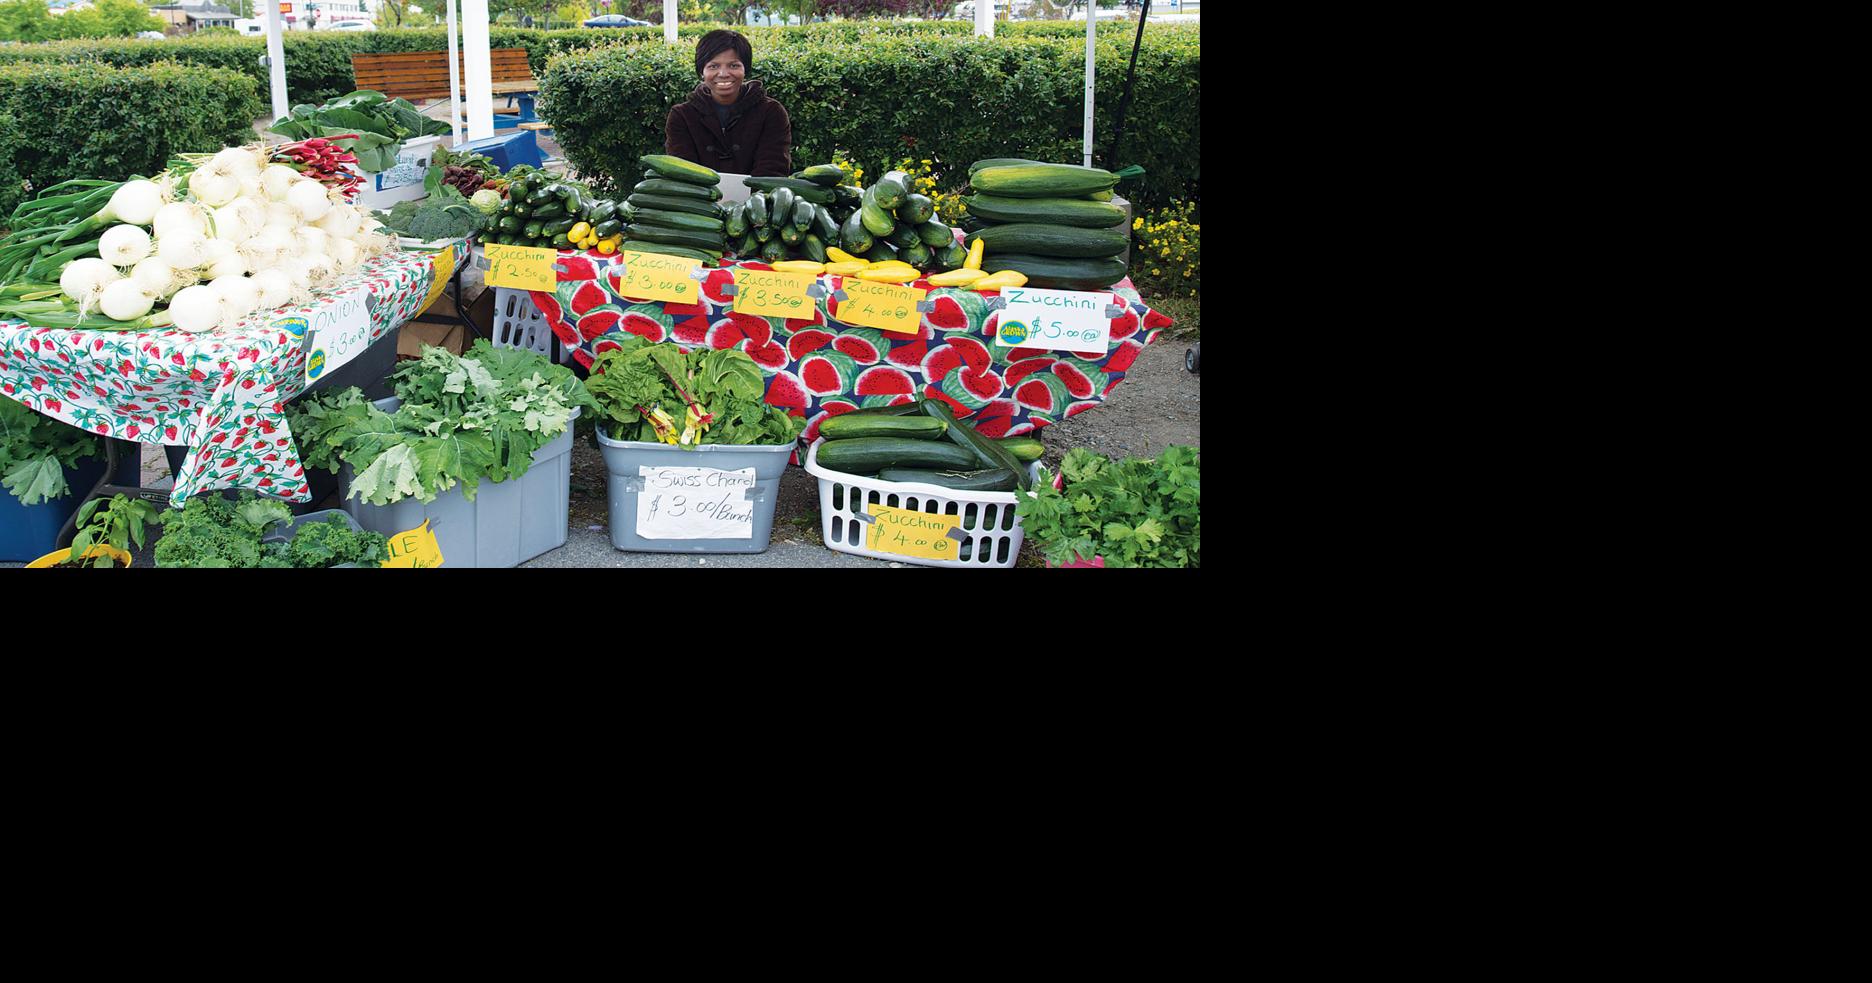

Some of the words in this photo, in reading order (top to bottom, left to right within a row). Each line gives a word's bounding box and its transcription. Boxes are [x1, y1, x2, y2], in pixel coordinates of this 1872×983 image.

[488, 246, 545, 260] Zucchini
[627, 253, 687, 272] Zucchini
[738, 272, 800, 289] Zucchini
[847, 280, 913, 300] Zucchini
[1008, 290, 1097, 310] Zucchini
[315, 291, 360, 332] ONION
[653, 470, 702, 488] Swiss
[705, 471, 754, 488] Chard
[874, 508, 945, 530] Zucchini
[389, 535, 418, 557] LE
